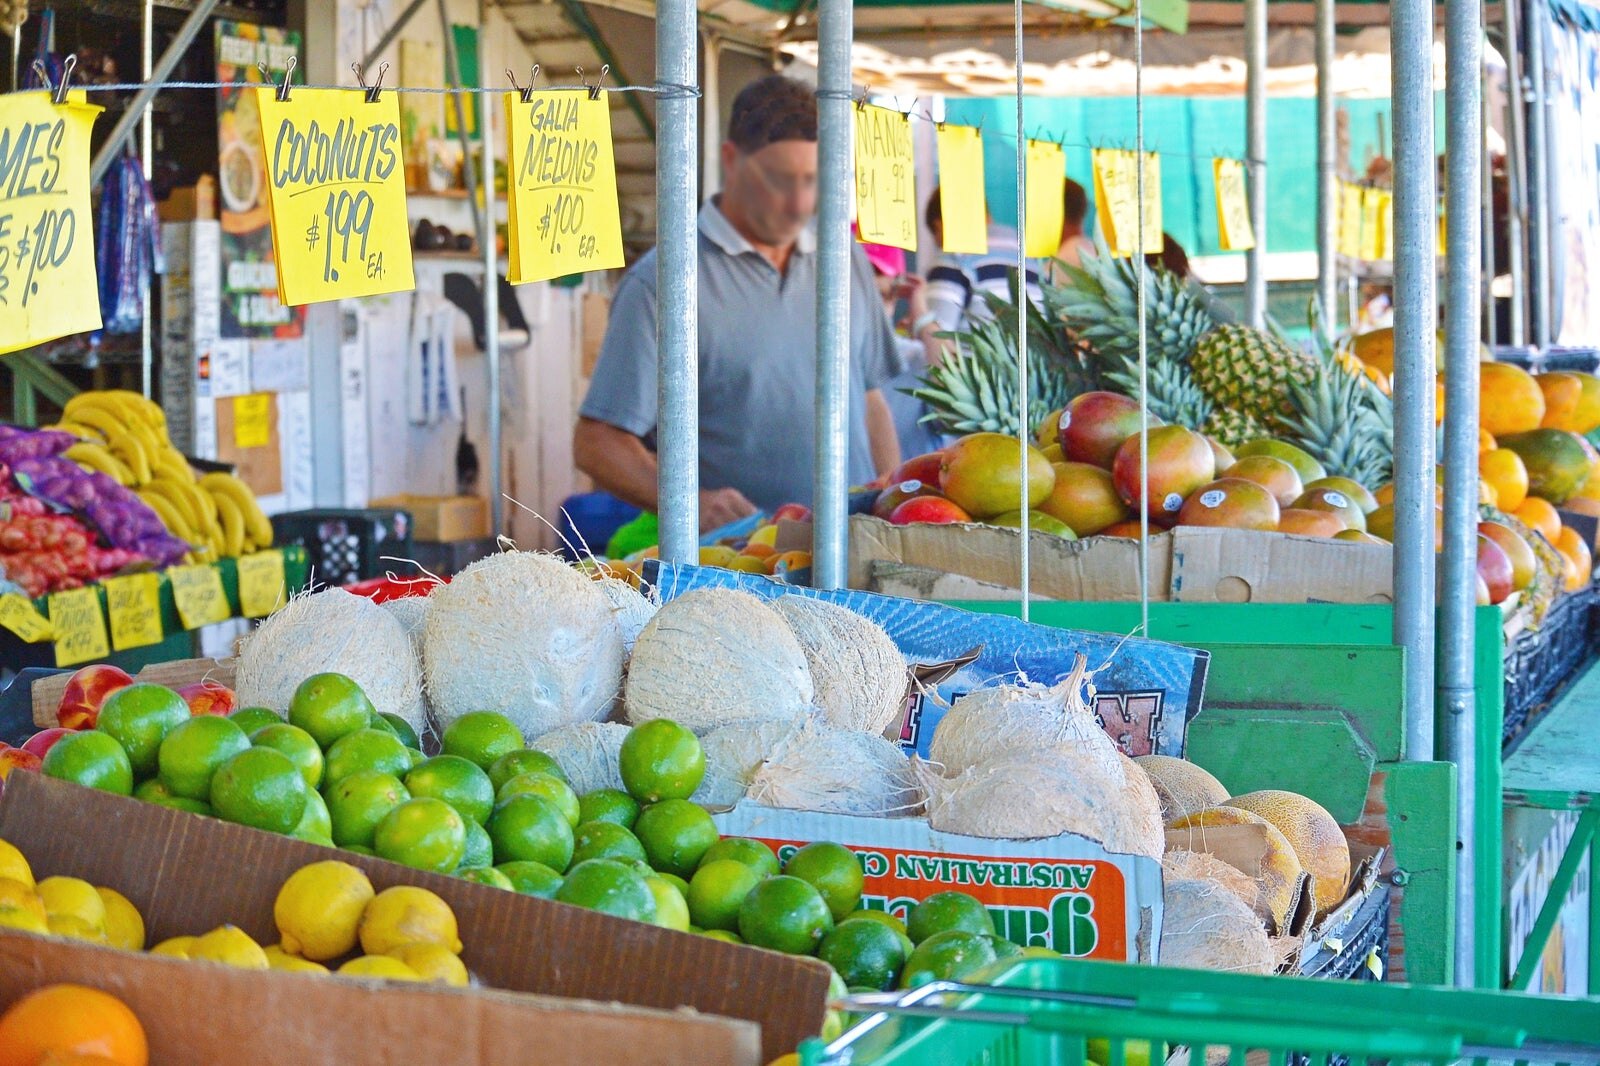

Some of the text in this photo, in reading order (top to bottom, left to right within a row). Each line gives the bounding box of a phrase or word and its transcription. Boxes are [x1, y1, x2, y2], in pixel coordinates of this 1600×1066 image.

[530, 97, 579, 132] GALIA
[273, 116, 398, 189] COCONUTS
[519, 134, 598, 186] MELONS
[13, 208, 76, 308] $1.00
[305, 190, 386, 283] $1.99 EA.
[537, 193, 600, 259] $1.00 EA.
[897, 854, 1095, 889] AUSTRALIAN
